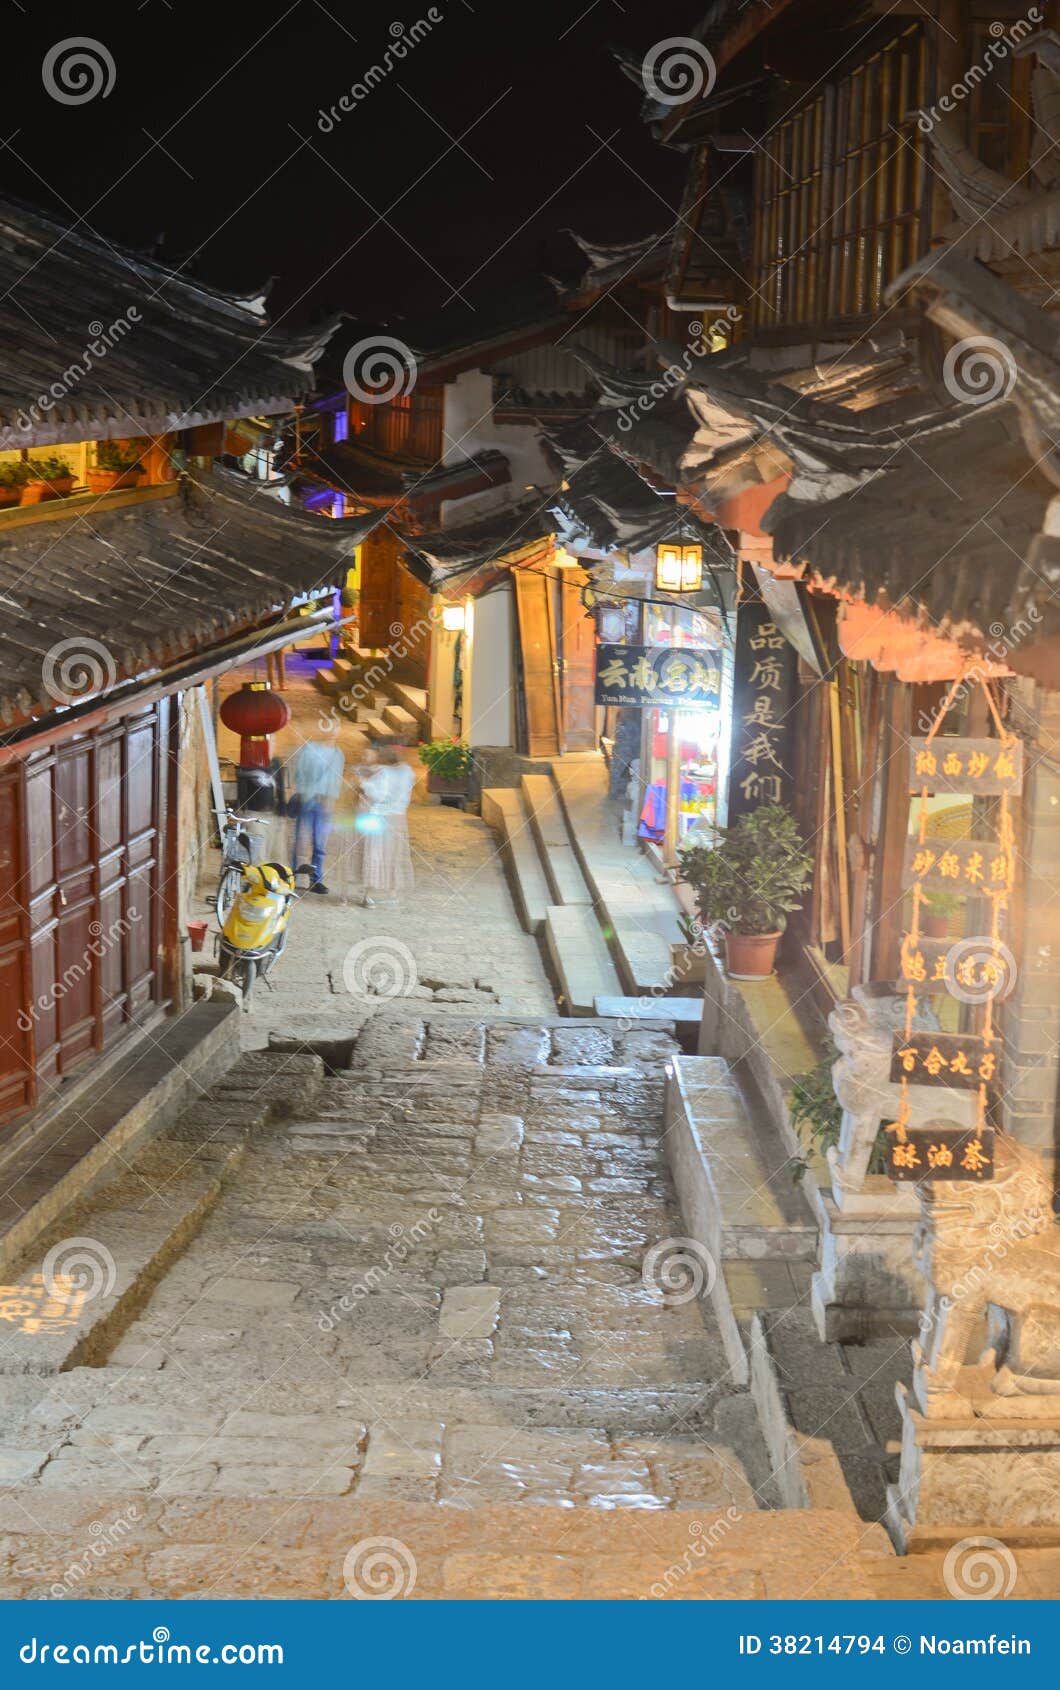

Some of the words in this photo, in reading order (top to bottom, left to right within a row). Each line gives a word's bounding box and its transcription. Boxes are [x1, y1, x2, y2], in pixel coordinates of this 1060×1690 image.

[598, 656, 721, 694] 云南名烟
[739, 622, 787, 803] 品质是我们
[898, 1046, 996, 1080] 百合丸子
[892, 1139, 990, 1171] 酥油茶
